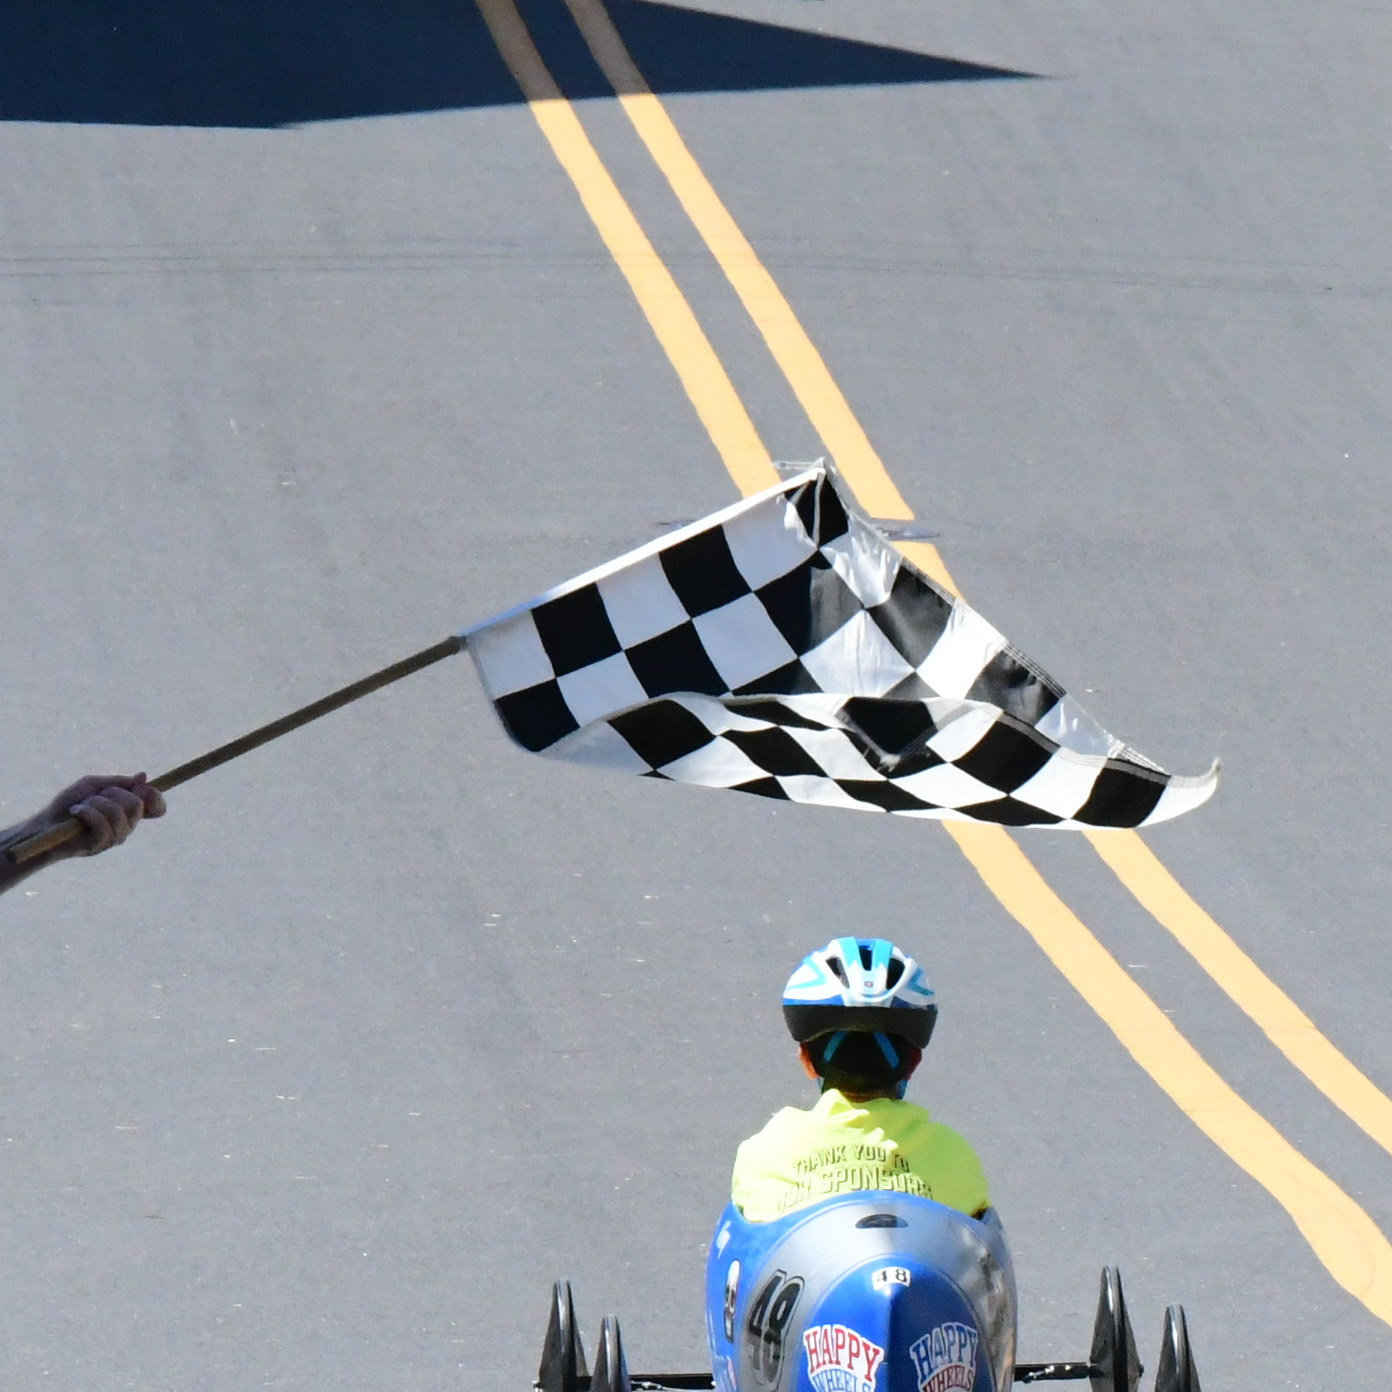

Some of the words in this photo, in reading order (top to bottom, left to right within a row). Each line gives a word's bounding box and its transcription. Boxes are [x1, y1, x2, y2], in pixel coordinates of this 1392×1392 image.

[793, 1145, 847, 1178] THANK
[852, 1144, 887, 1163] YOU
[894, 1153, 910, 1174] TO
[821, 1165, 933, 1201] SPONSORS
[876, 1268, 909, 1284] 48
[805, 1327, 880, 1383] HAPPY
[913, 1324, 979, 1382] HAPPY
